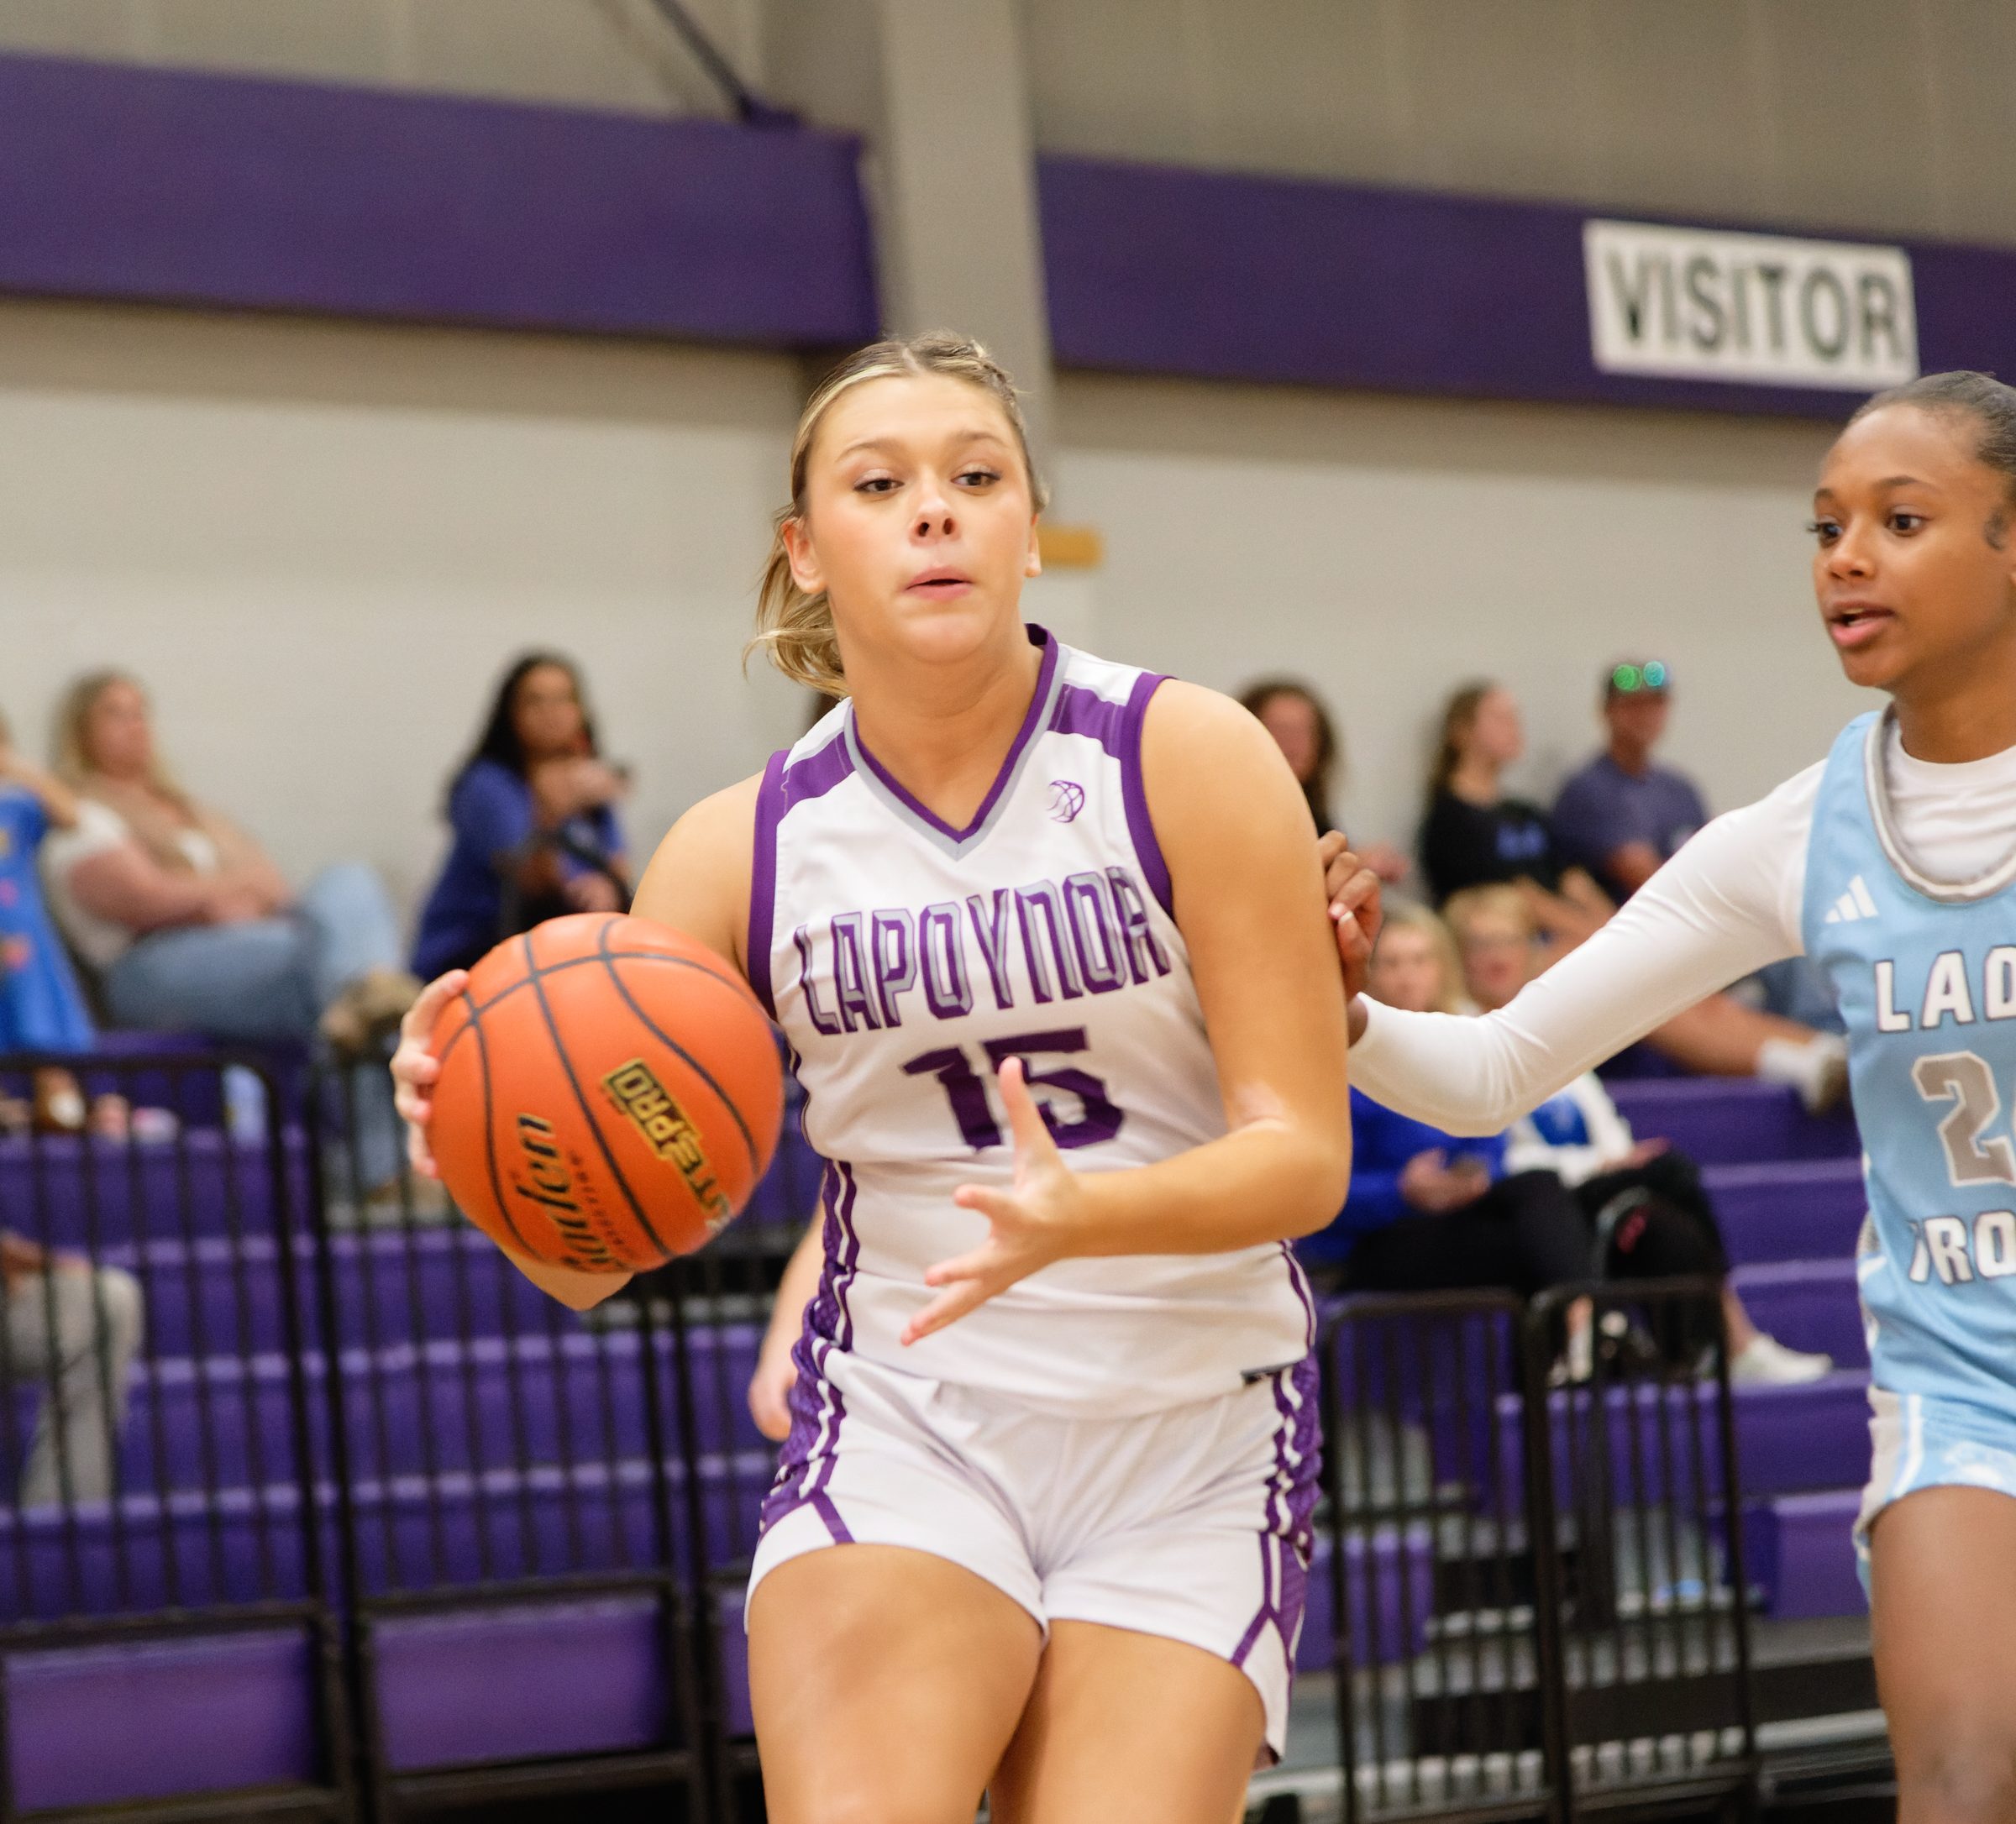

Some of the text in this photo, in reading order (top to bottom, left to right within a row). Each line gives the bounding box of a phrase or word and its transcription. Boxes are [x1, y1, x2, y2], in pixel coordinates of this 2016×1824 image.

[1604, 250, 1905, 364] VISITOR
[793, 865, 1172, 1036] LAPOYNOR
[901, 1022, 1126, 1153] 15
[1911, 1050, 2016, 1188] 2
